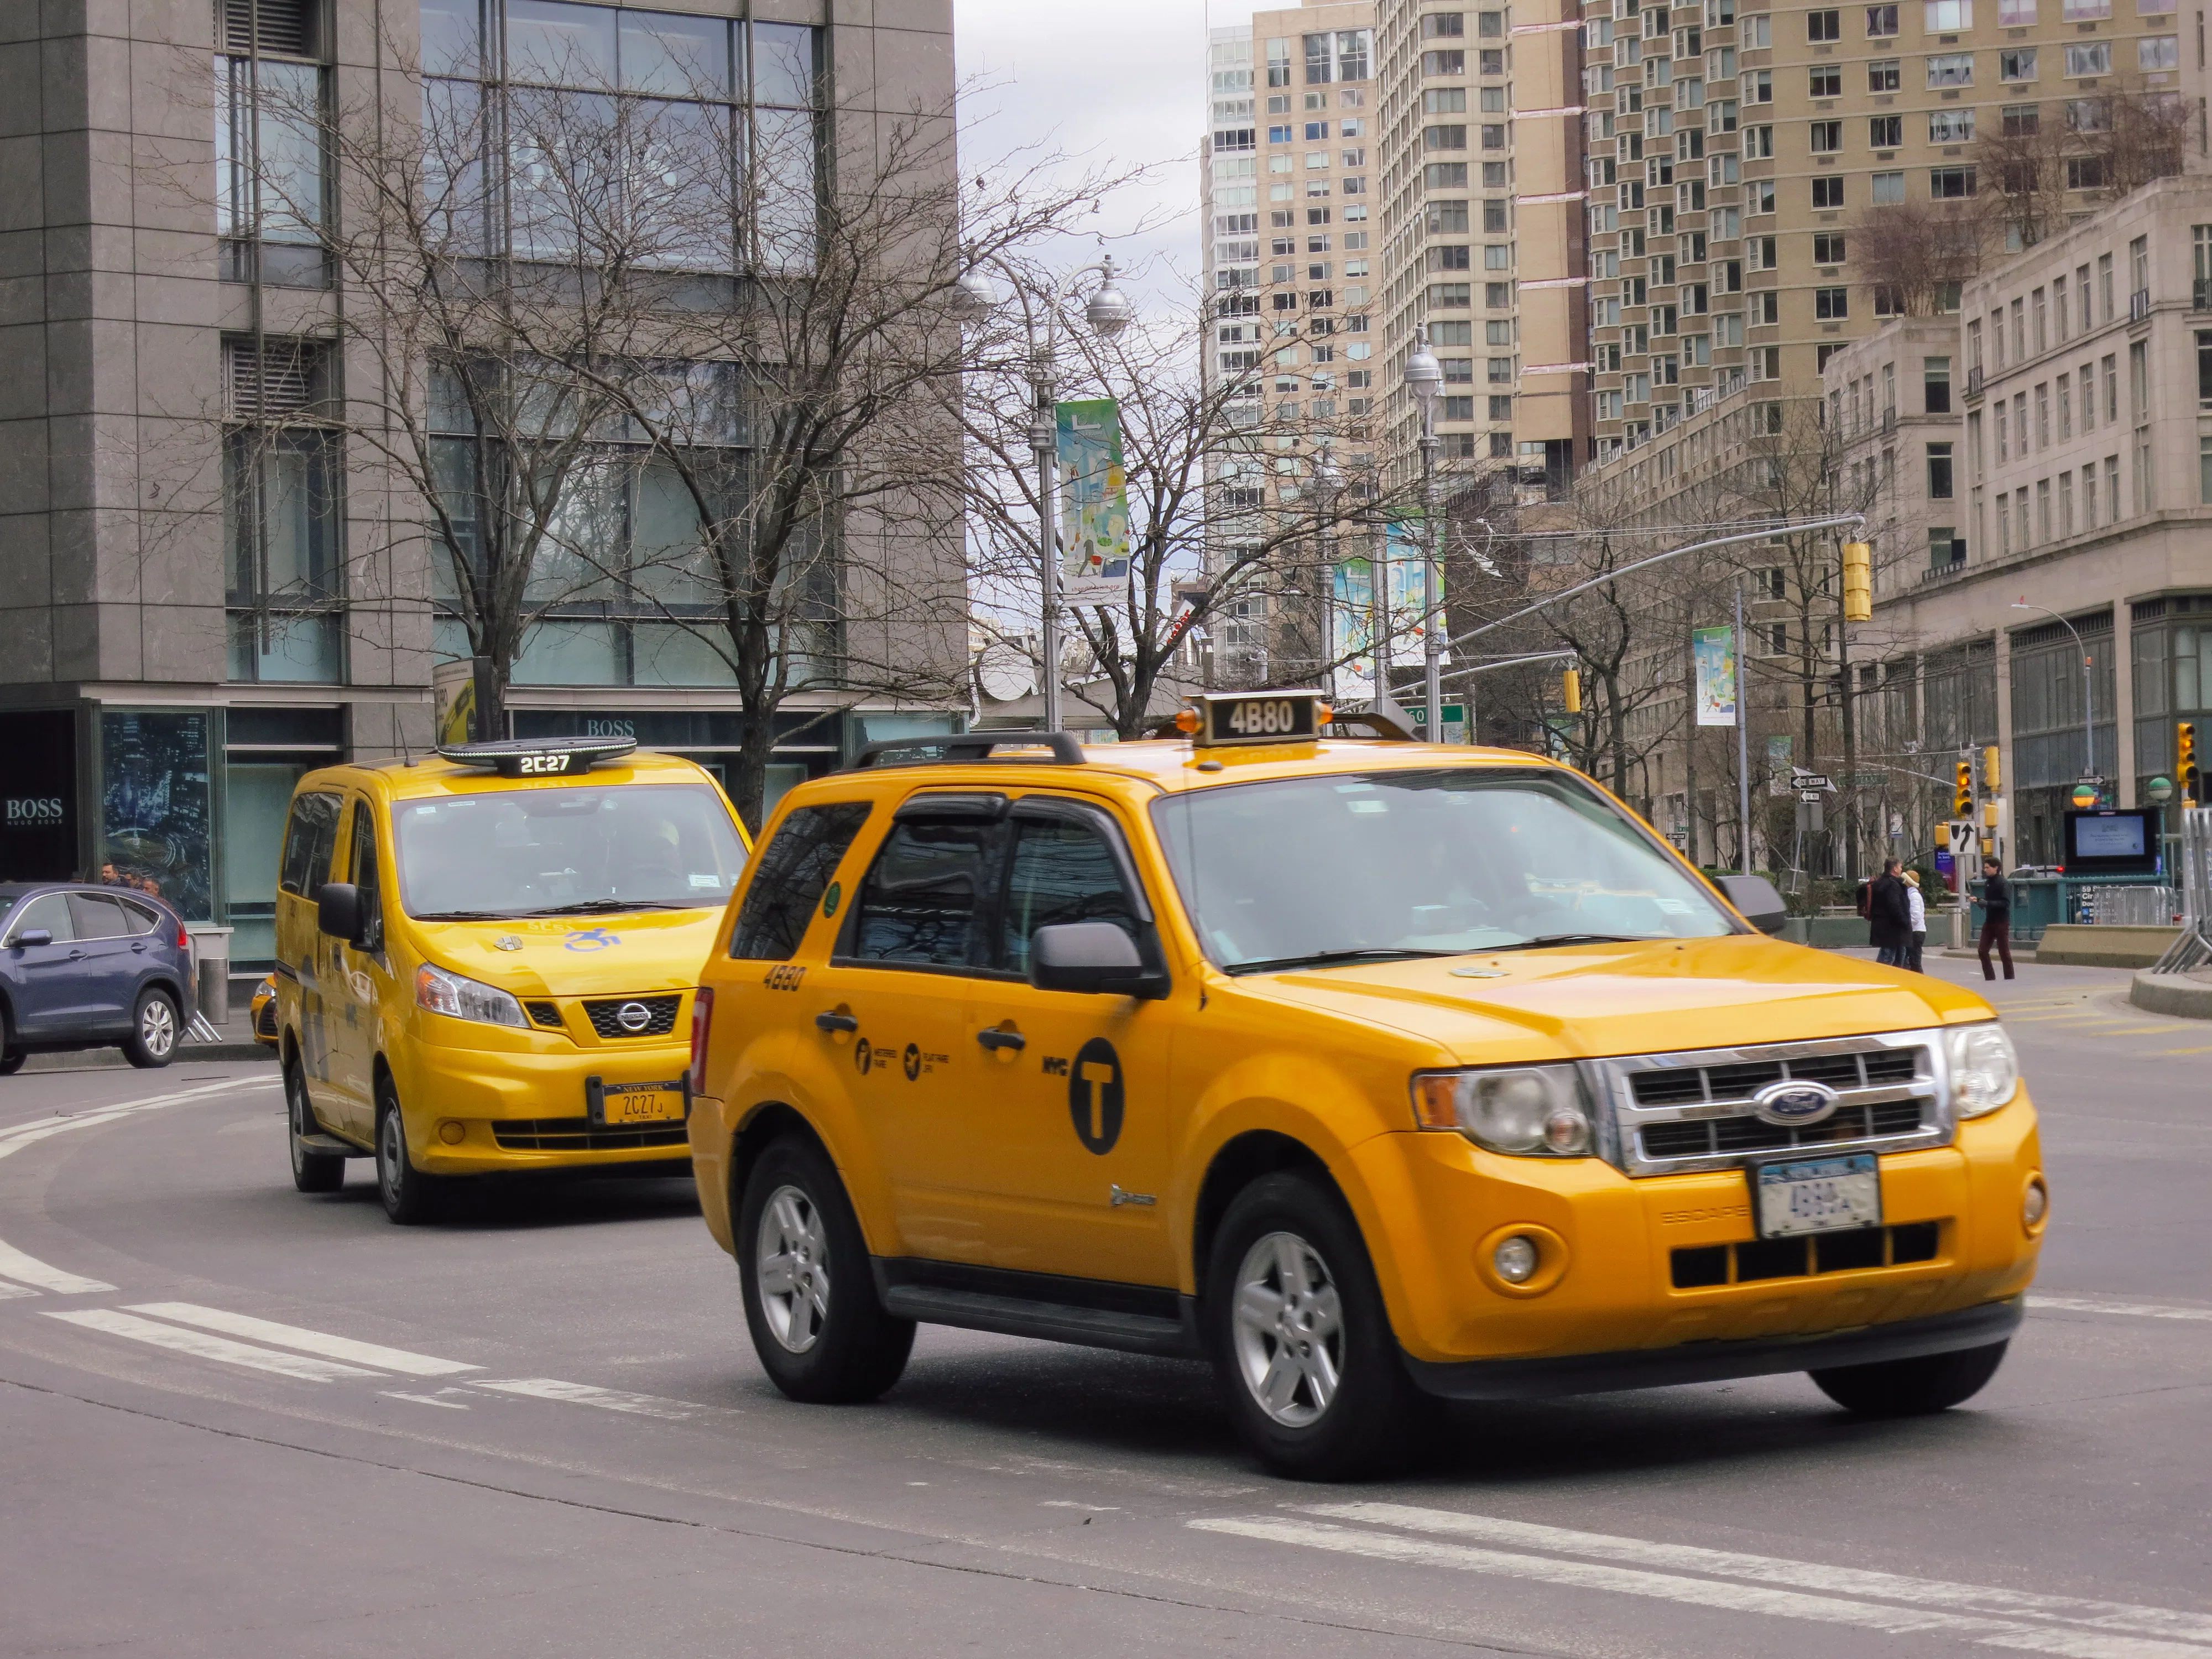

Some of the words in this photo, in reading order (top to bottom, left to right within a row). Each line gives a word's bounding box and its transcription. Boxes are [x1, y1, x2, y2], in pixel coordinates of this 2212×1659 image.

[1229, 701, 1294, 733] 4B80
[1408, 710, 1425, 722] 60
[587, 719, 634, 737] BOSS
[520, 754, 570, 773] 2C27
[7, 799, 62, 818] BOSS
[1661, 1204, 1750, 1225] ESCAPE
